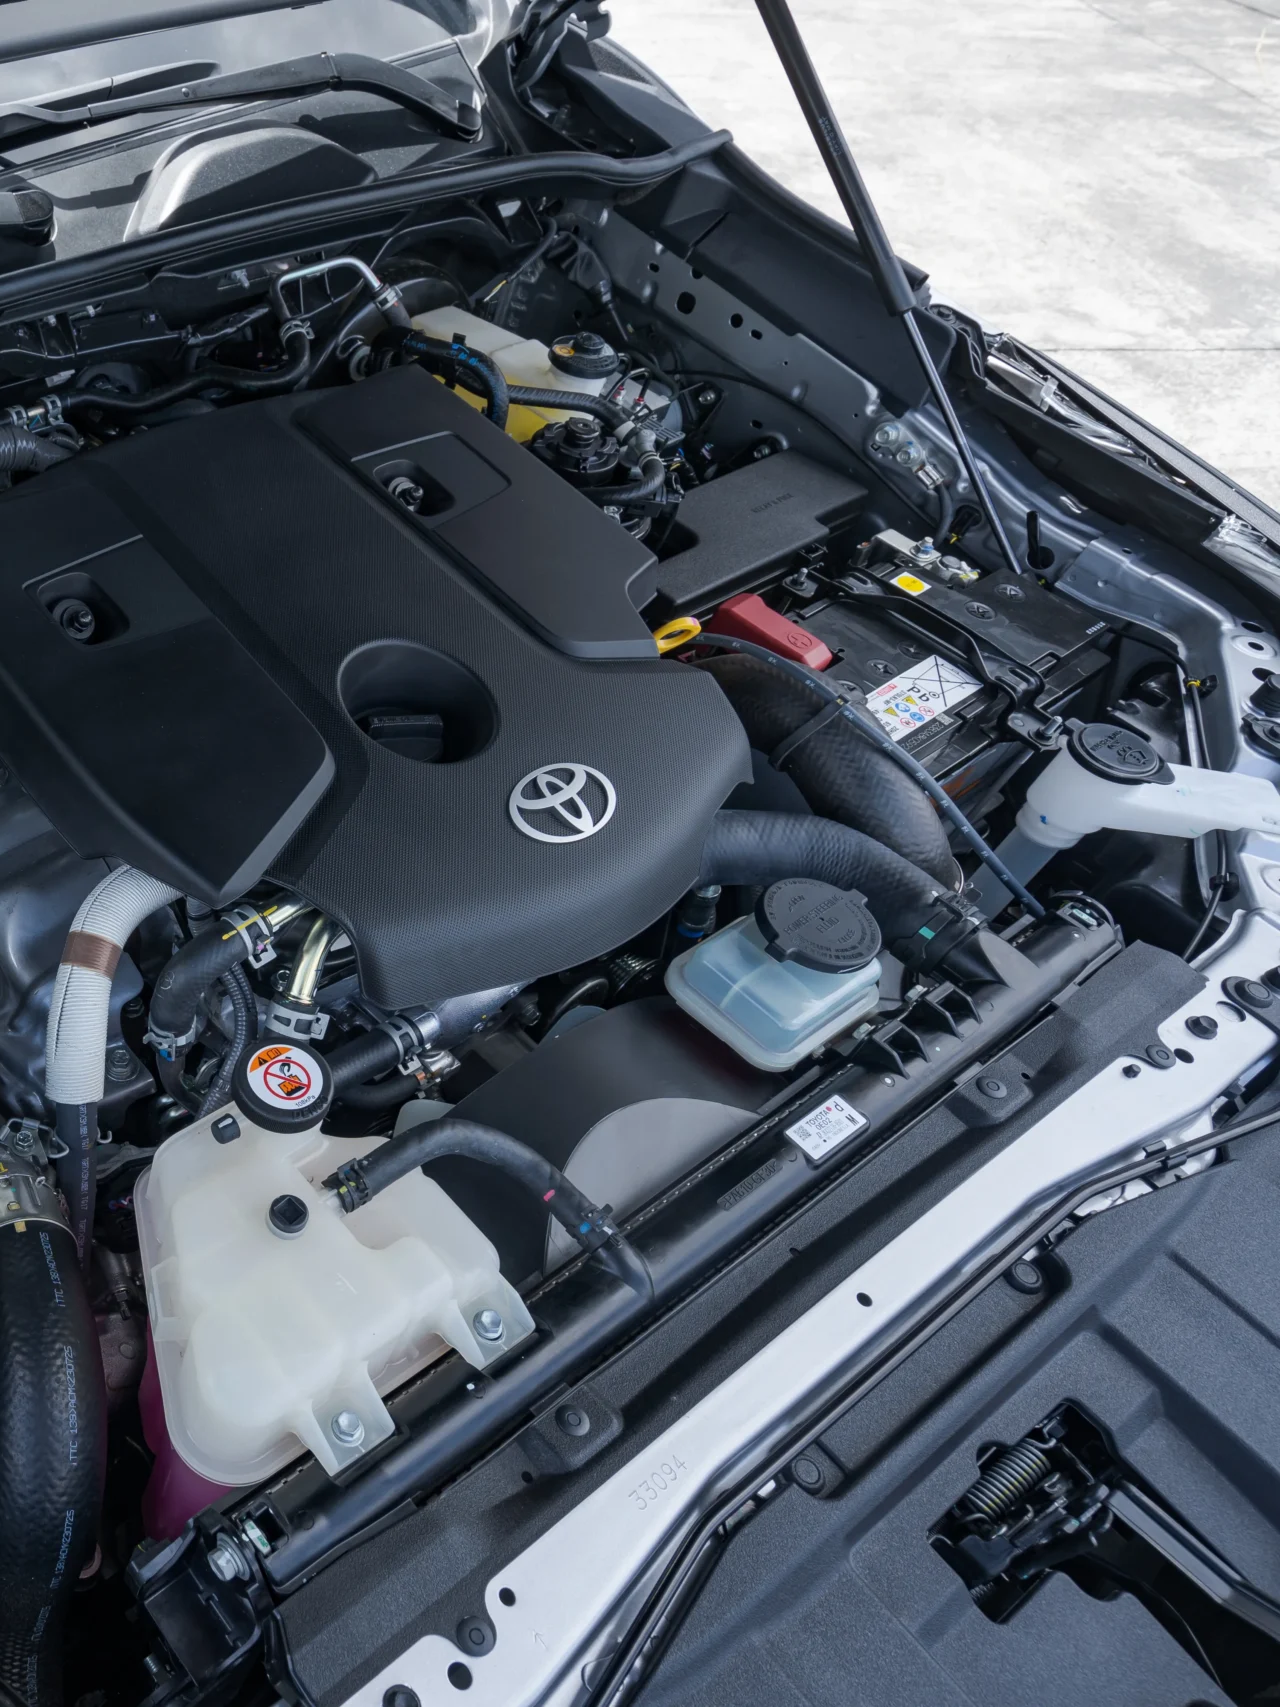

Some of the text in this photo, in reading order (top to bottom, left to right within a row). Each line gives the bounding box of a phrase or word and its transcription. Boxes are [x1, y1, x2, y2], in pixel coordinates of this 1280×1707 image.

[784, 913, 810, 936] POWER
[808, 894, 844, 921] STEERING
[294, 1094, 316, 1108] 108kPa
[804, 1107, 830, 1129] TOYOTA
[625, 1450, 691, 1513] 33094
